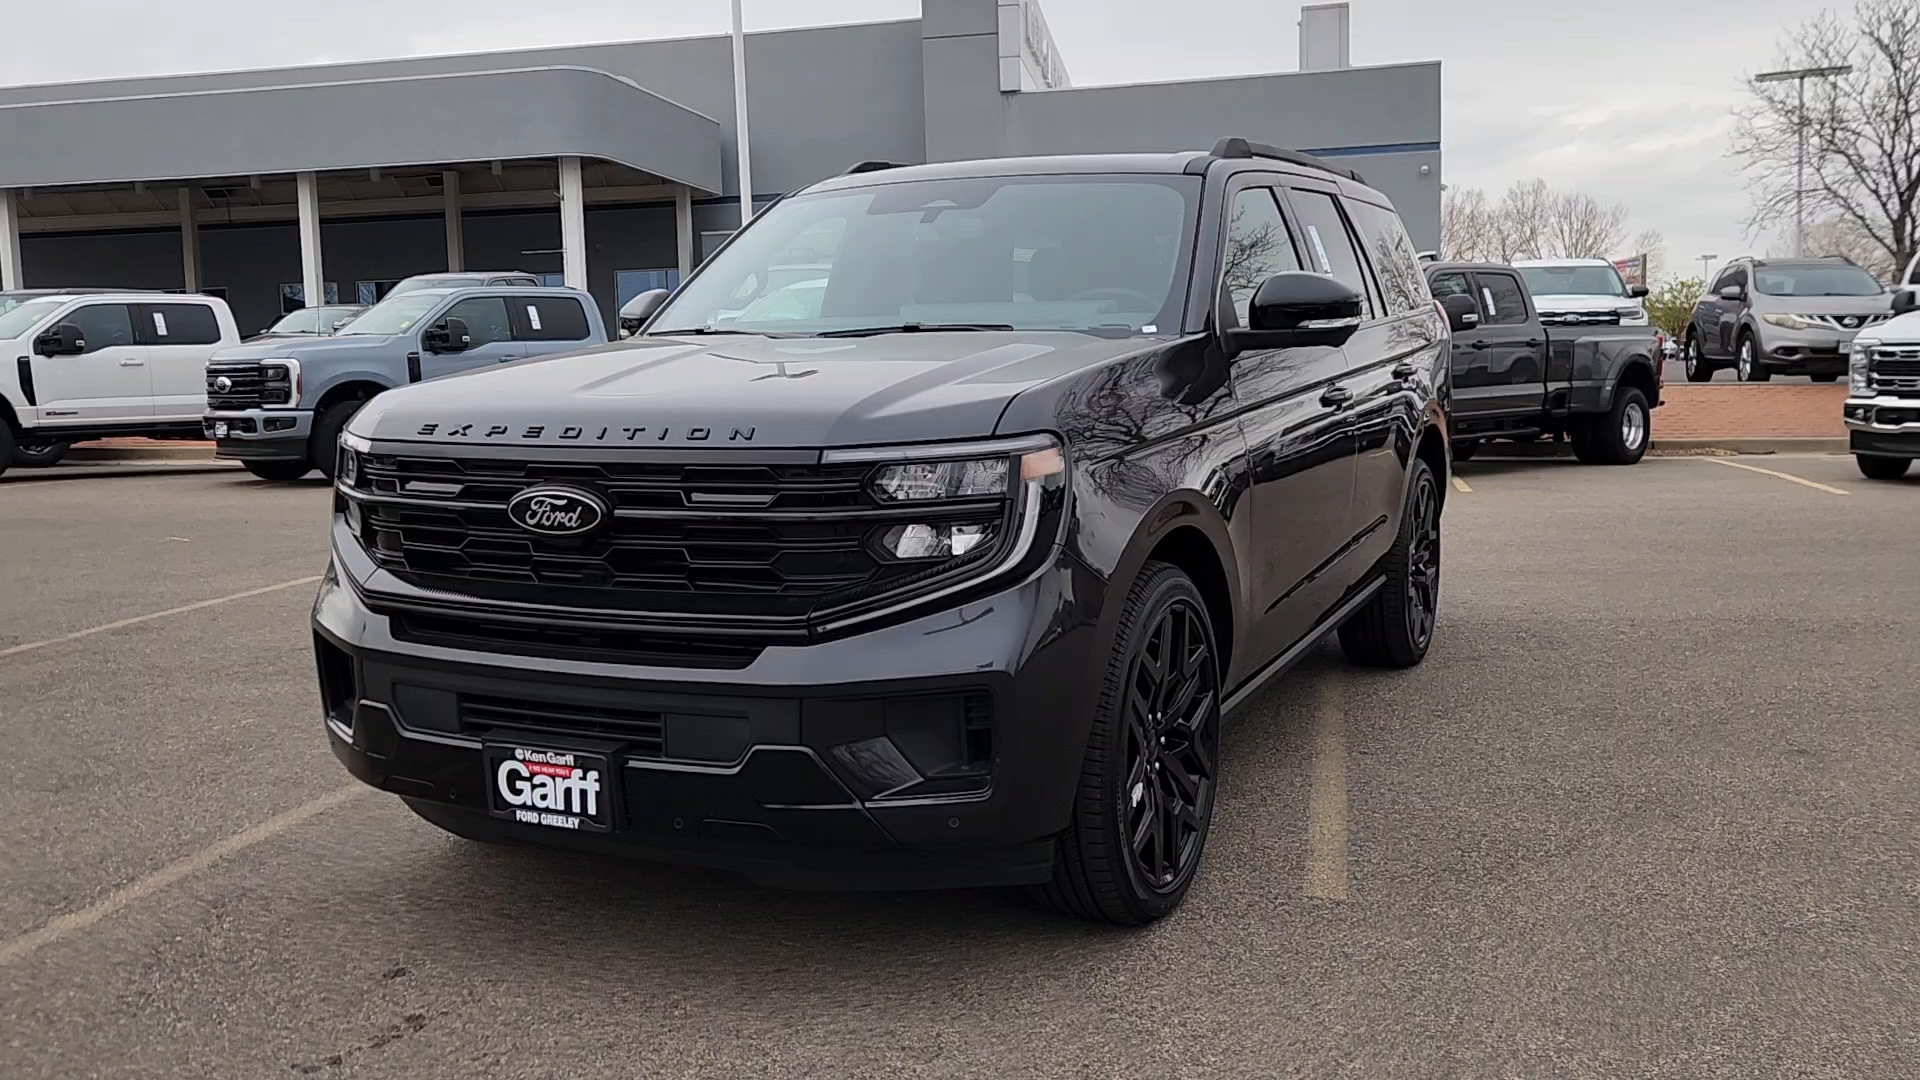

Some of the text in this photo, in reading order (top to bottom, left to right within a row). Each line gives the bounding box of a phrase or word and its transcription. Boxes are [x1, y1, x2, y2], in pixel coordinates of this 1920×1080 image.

[417, 423, 756, 441] EXPEDITION
[525, 496, 583, 528] Ford
[524, 750, 574, 766] Ken Garff
[497, 760, 600, 815] Garff
[516, 810, 580, 829] FORD GREELEY
